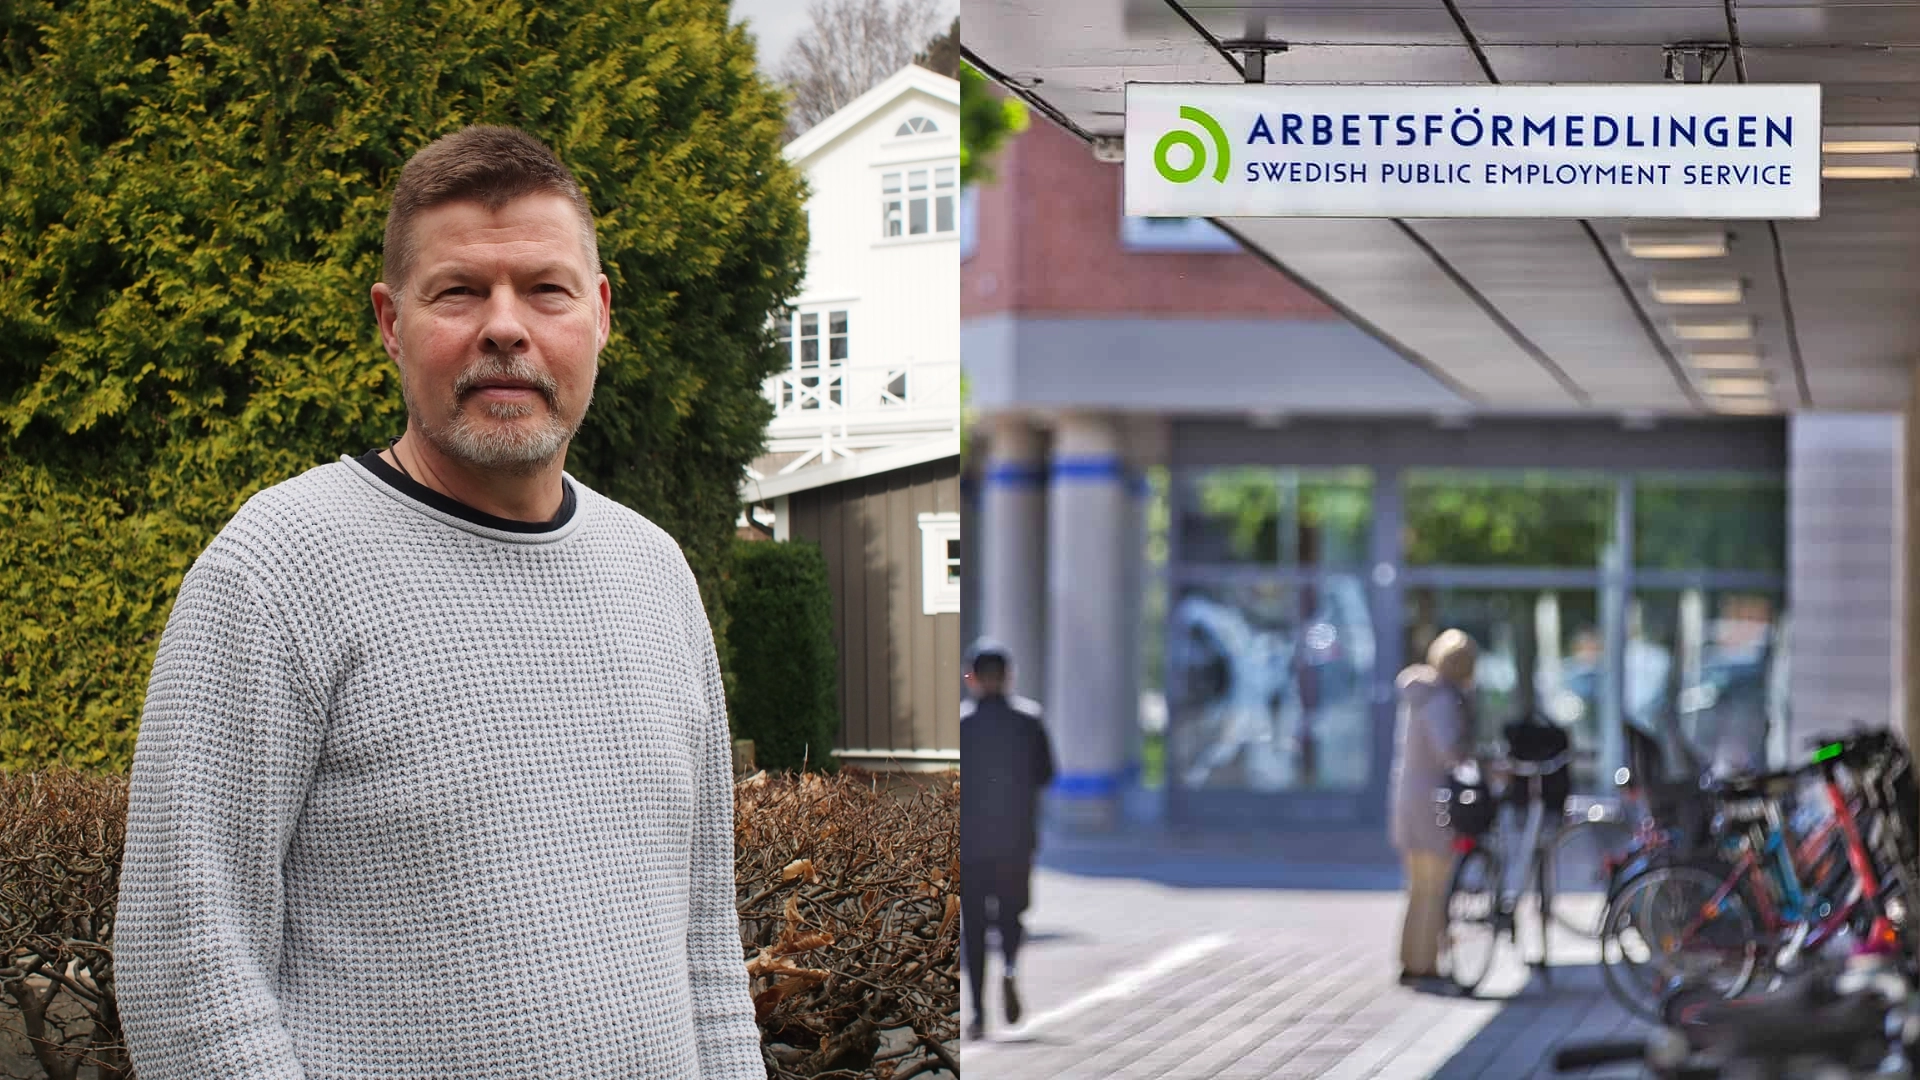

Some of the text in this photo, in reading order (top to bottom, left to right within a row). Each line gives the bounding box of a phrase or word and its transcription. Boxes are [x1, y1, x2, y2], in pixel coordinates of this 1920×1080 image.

[1246, 107, 1793, 148] ARBETSFÖRMEDLINGEN
[1246, 161, 1792, 186] SWEDISH PUBLIC EMPLOYMENT SERVICE
